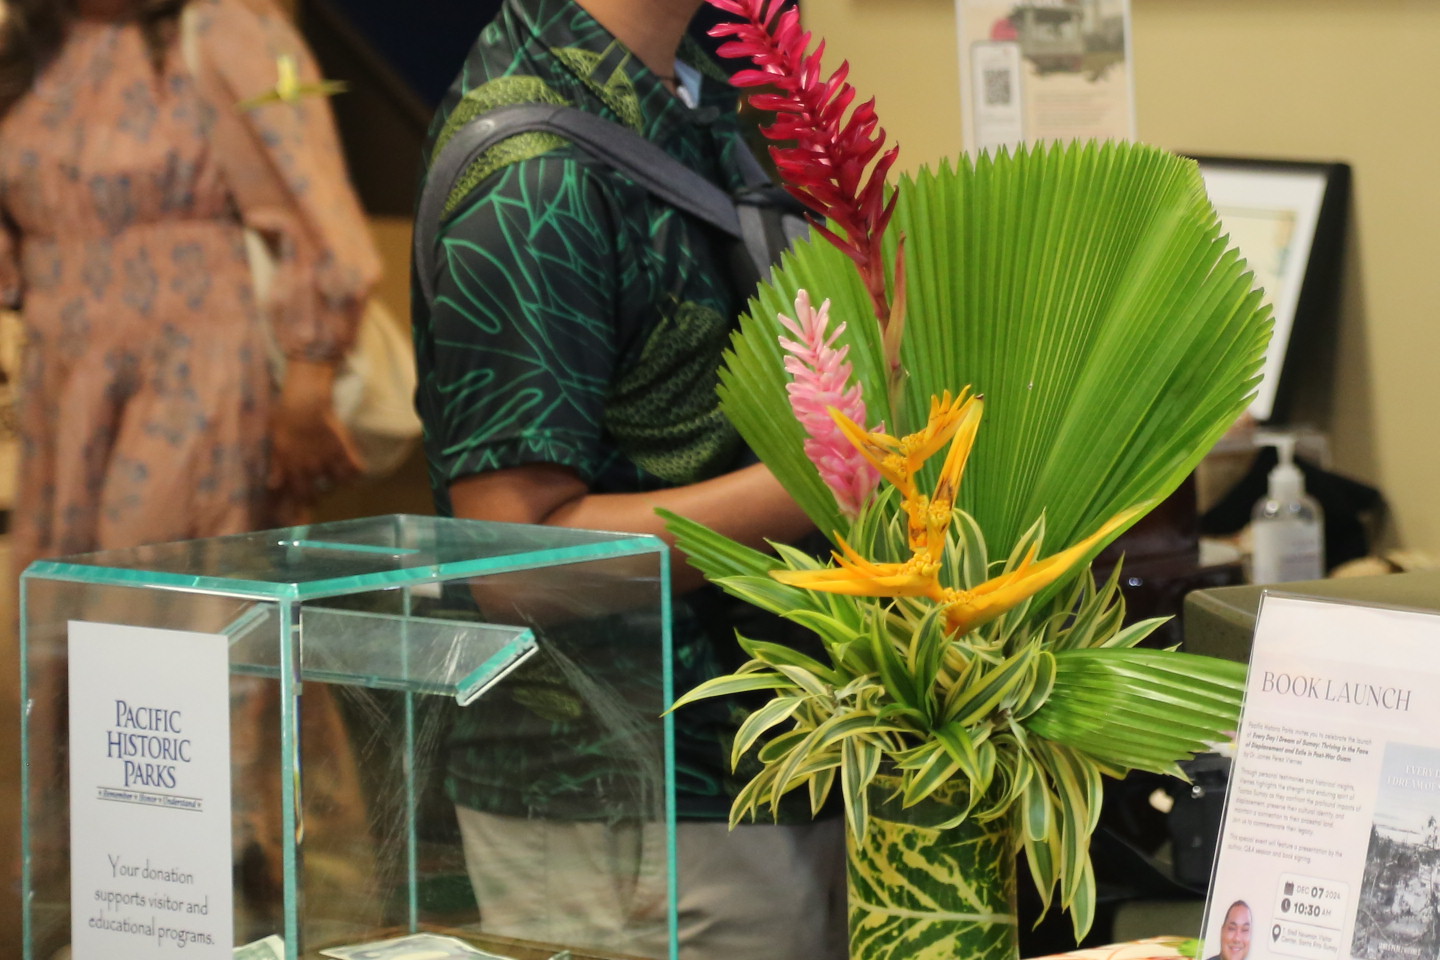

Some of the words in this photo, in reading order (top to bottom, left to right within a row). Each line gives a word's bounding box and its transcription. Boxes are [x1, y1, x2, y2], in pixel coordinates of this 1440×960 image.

[1262, 671, 1321, 699] BOOK
[1325, 680, 1411, 711] LAUNCH
[115, 700, 181, 733] PACIFIC
[106, 730, 191, 762] HISTORIC
[123, 760, 176, 789] PARKS
[107, 853, 140, 878] Your
[141, 858, 194, 885] donation
[94, 889, 146, 912] supports
[148, 893, 184, 912] visitor
[186, 895, 208, 915] and
[1296, 885, 1310, 895] DEC
[1311, 886, 1324, 899] 07
[1325, 891, 1340, 900] 2024
[1294, 902, 1320, 917] 10:30
[88, 909, 155, 936] educational
[158, 926, 215, 948] programs.
